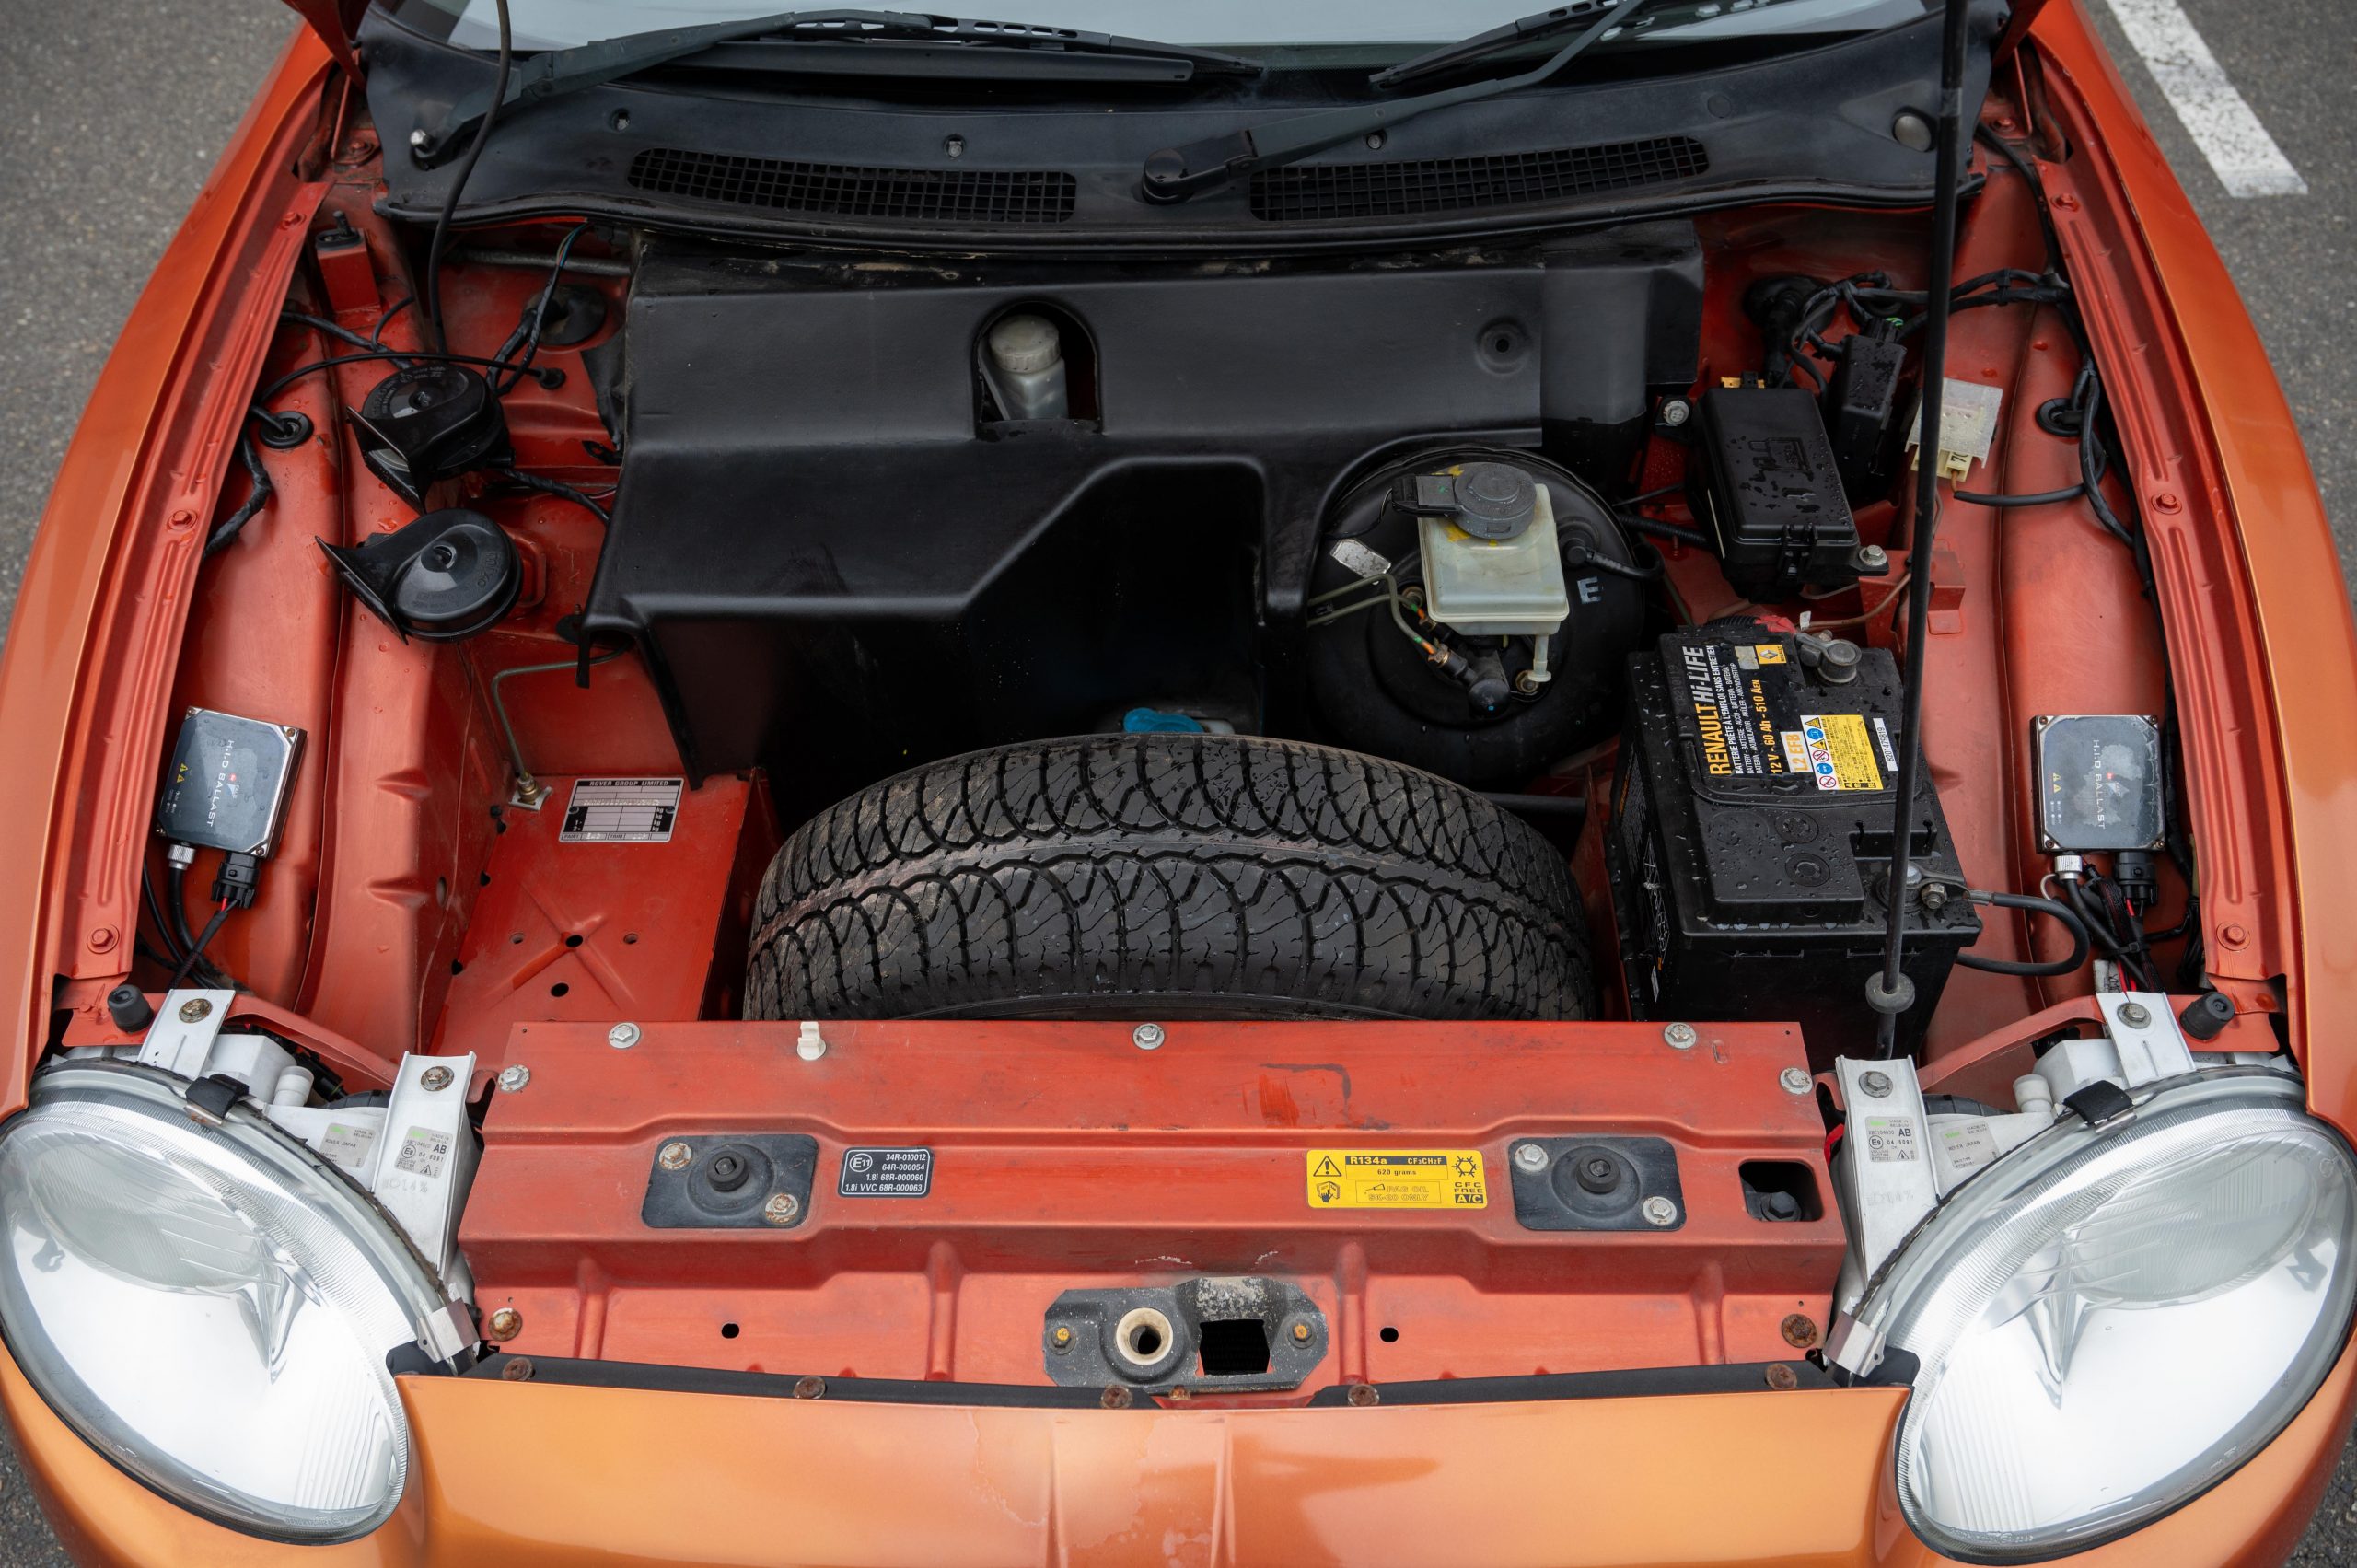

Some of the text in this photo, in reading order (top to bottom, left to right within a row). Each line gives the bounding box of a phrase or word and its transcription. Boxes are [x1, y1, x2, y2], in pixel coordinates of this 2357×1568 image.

[1577, 576, 1602, 604] E
[1706, 645, 1720, 676] ENTRETIEN
[1713, 677, 1724, 692] SANS
[1717, 693, 1730, 720] L'EMPLOI
[1728, 688, 1738, 709] BATTERIA
[1753, 695, 1767, 713] 510
[1682, 646, 1731, 774] RENAULT Hi-LIFE
[1734, 712, 1742, 725] ACCU
[1724, 726, 1736, 745] PRÊTE
[1745, 720, 1758, 751] AKUMULATOR
[1759, 720, 1772, 732] Ah
[1737, 728, 1748, 750] BATTERIE
[1763, 735, 1775, 746] 60
[1730, 746, 1743, 773] BATTERIE
[1785, 734, 1808, 772] L2 EFB
[1744, 754, 1754, 773] BATTERY
[1771, 762, 1782, 773] 12
[206, 739, 235, 827] H.I.D BALLAST
[2093, 739, 2106, 830] H.I.D BALLAST
[1898, 1128, 1912, 1137] AB
[433, 1144, 447, 1154] AB
[1350, 1156, 1387, 1165] R134a
[1457, 1194, 1483, 1203] A/C
